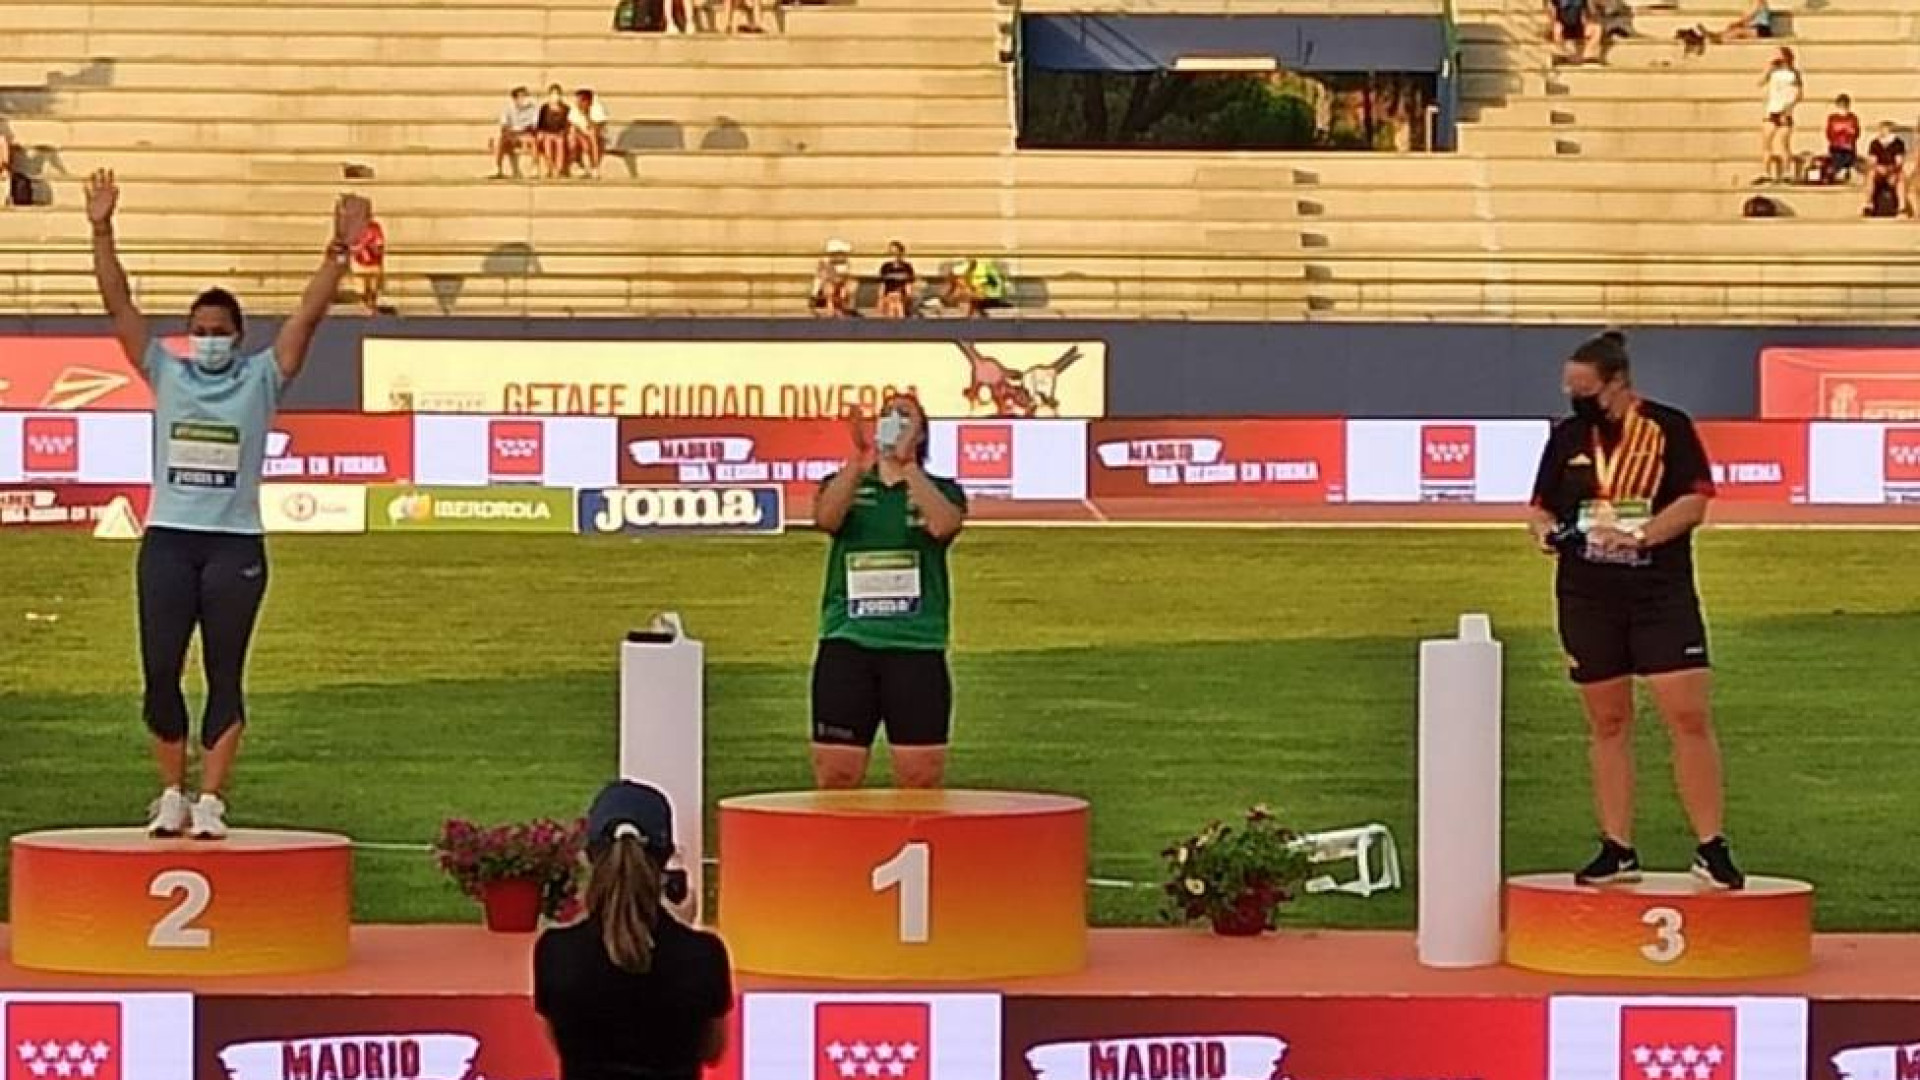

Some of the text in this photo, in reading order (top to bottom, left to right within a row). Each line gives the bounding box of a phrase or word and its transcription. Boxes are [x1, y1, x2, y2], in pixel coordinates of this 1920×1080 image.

[503, 382, 628, 414] GETAFE
[641, 383, 763, 416] CIUDAD
[148, 870, 212, 949] 2
[872, 842, 930, 943] 1
[1639, 907, 1686, 962] 3
[281, 1039, 420, 1080] MADRID
[1090, 1040, 1227, 1080] MADRID
